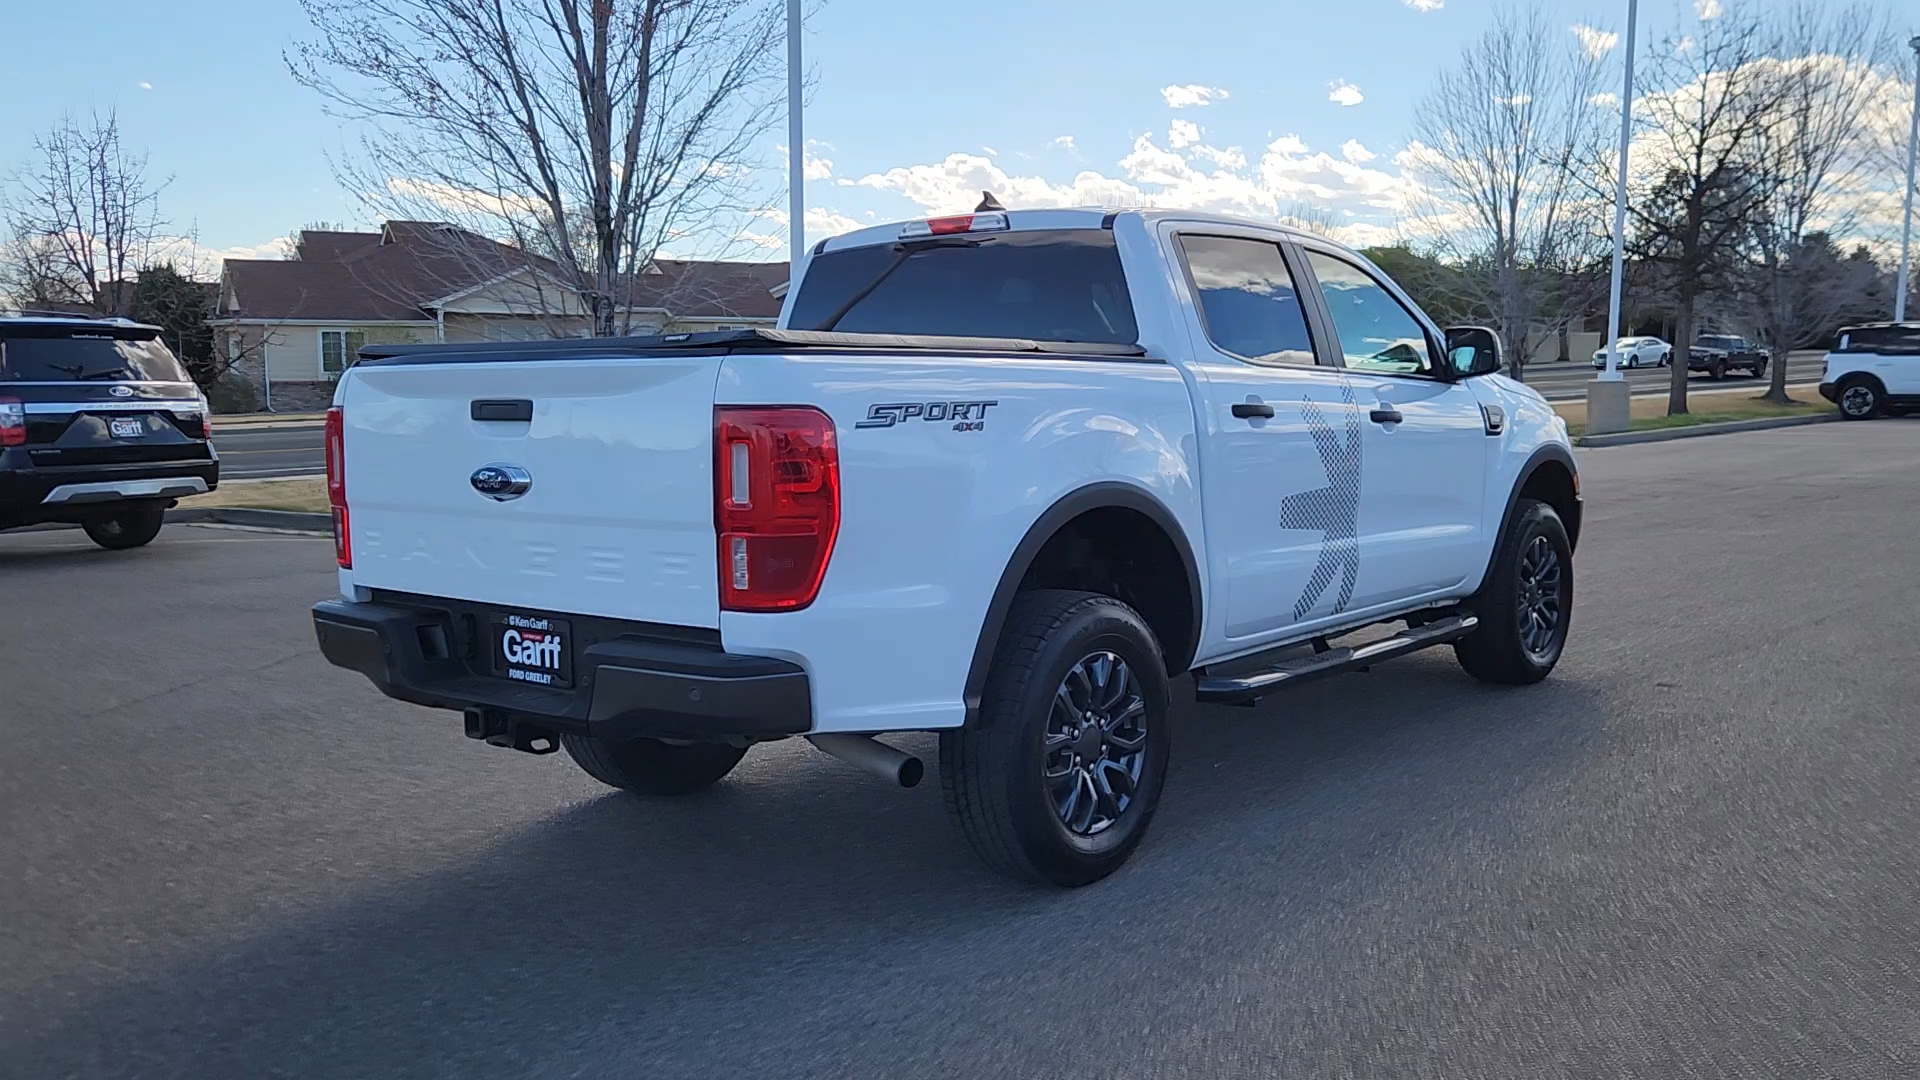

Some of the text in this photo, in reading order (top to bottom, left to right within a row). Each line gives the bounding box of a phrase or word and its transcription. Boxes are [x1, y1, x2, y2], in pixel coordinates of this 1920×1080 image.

[855, 400, 998, 429] SPORT
[111, 421, 143, 435] Garff
[474, 470, 502, 489] Ford
[515, 616, 548, 630] Ken Garff
[503, 629, 560, 669] Garff
[509, 669, 551, 684] FORD GREELEY
